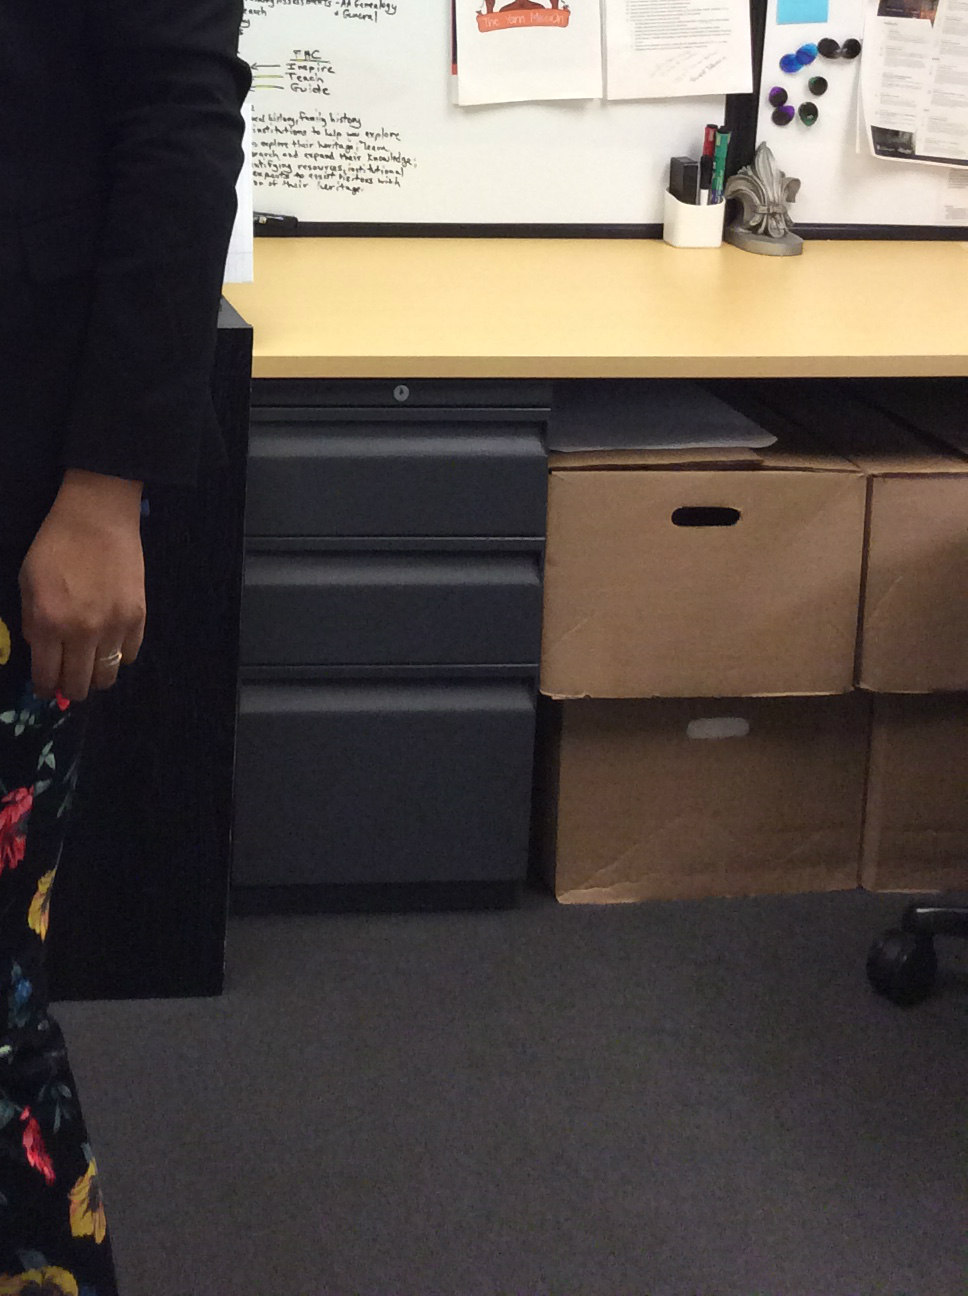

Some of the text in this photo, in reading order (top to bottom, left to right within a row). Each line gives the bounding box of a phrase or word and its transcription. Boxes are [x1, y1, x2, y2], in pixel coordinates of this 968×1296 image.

[286, 62, 336, 74] Inspire
[285, 72, 325, 84] Teach
[290, 83, 331, 96] Guide
[329, 112, 362, 129] history
[311, 126, 321, 136] to
[324, 128, 342, 141] help
[365, 128, 402, 142] explore
[282, 150, 299, 159] and
[294, 171, 305, 179] to
